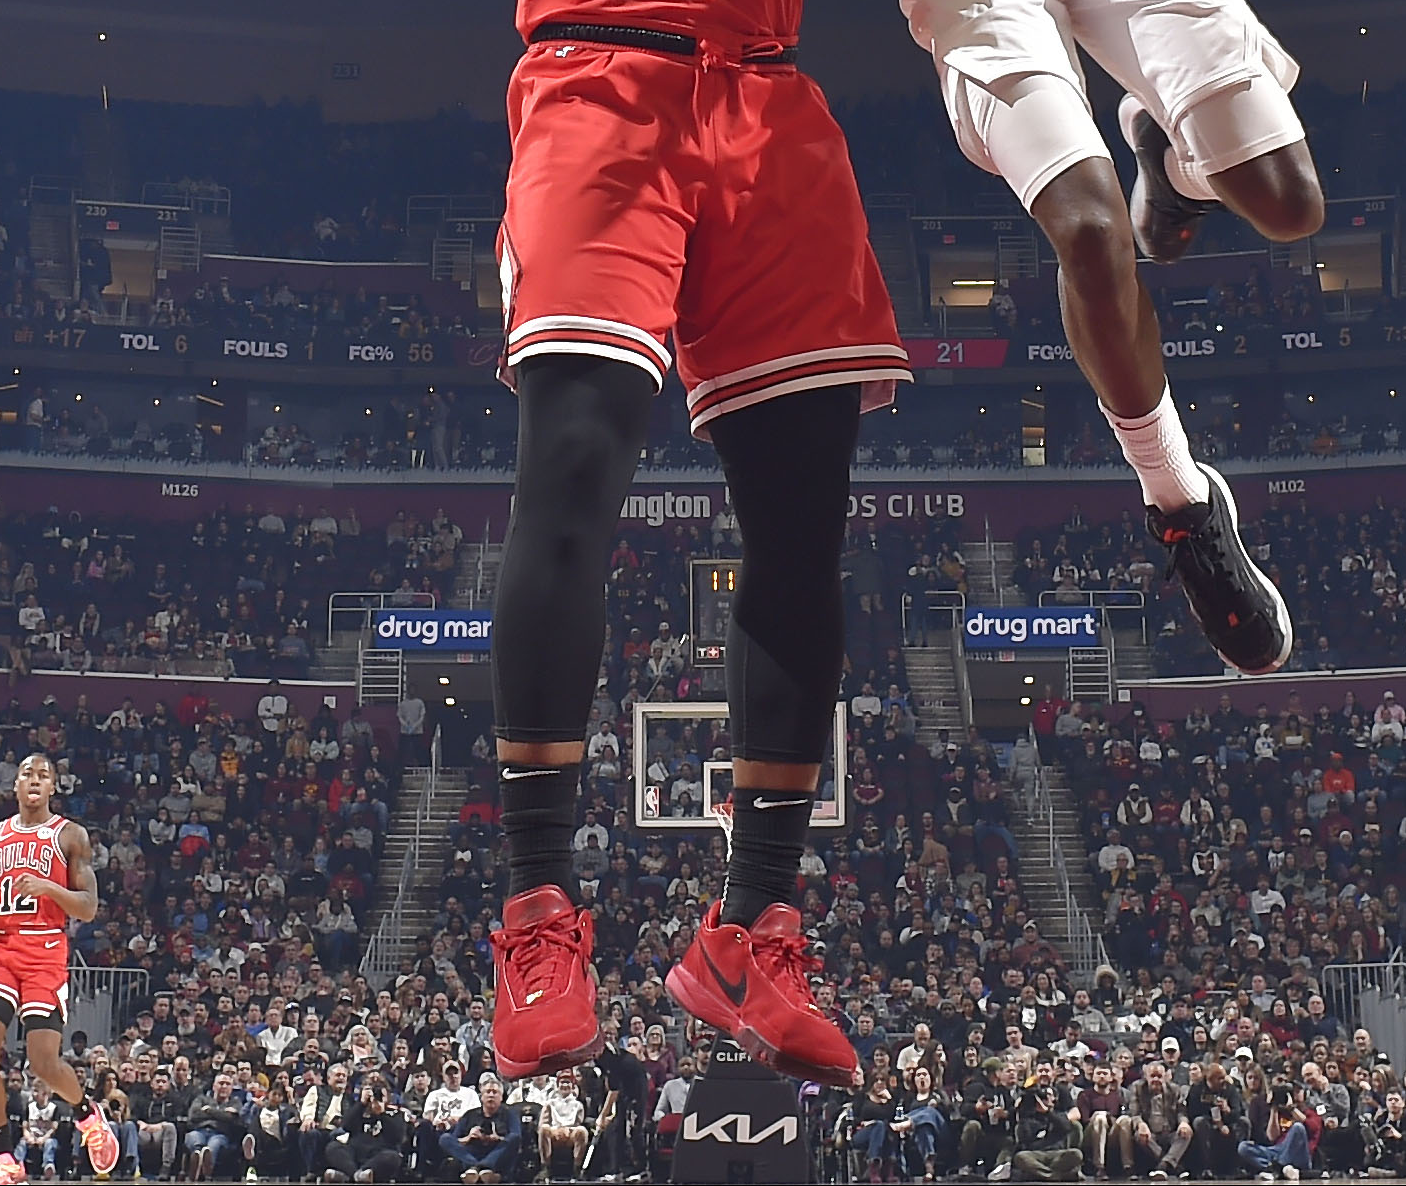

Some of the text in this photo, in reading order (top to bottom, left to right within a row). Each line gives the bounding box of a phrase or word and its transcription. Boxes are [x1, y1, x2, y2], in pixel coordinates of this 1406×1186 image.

[85, 206, 177, 221] 230 231
[456, 222, 476, 233] 231
[120, 333, 187, 353] TOL 6
[224, 339, 313, 360] FOULS 1
[1160, 336, 1247, 358] OULS 2
[1282, 329, 1351, 350] TOL 5
[349, 344, 434, 362] FG% 56
[937, 343, 965, 363] 21
[1029, 345, 1073, 361] FG%
[161, 483, 199, 498] M126
[1267, 479, 1305, 494] M102
[620, 492, 711, 527] ington
[713, 570, 735, 591] 11
[378, 615, 492, 645] drug mar
[966, 612, 1095, 642] drug mart
[716, 1052, 752, 1063] CLIF
[683, 1112, 797, 1146] KIA
